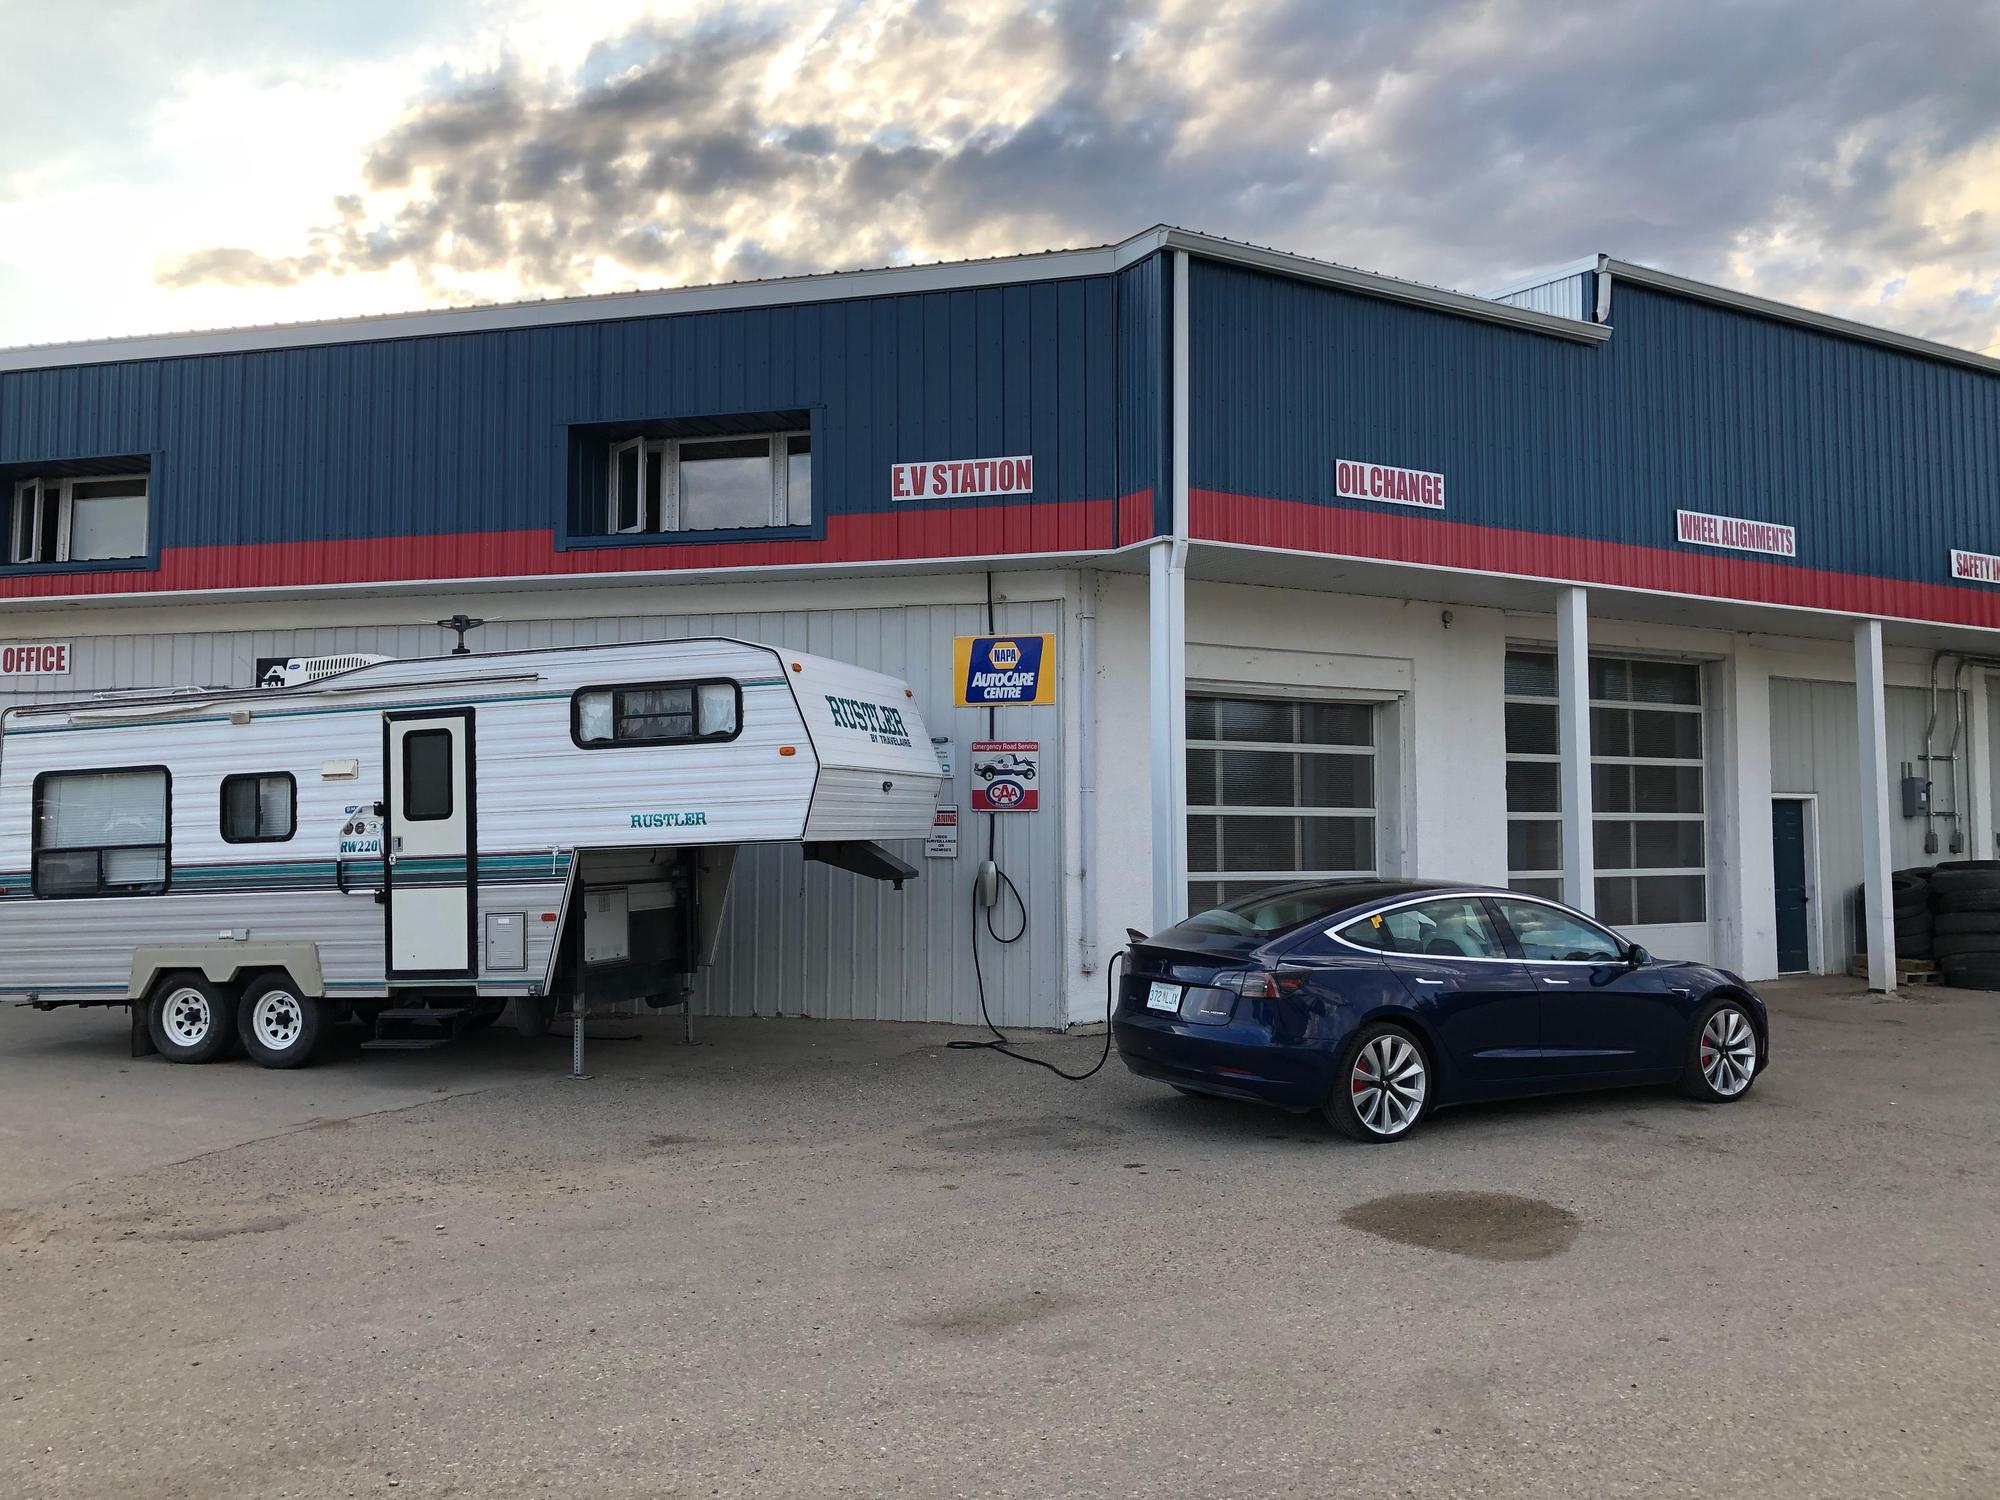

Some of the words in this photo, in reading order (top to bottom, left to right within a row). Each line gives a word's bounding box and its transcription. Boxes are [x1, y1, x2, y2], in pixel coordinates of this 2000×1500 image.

[893, 465, 927, 497] E.V
[932, 459, 1031, 495] STATION
[1338, 462, 1368, 496] OIL
[1370, 466, 1443, 506] CHANGE
[1679, 512, 1720, 544] WHEEL
[1721, 519, 1793, 555] ALIGNMENTS
[1956, 552, 1990, 580] SAFETY
[2, 645, 66, 673] OFFICE
[994, 649, 1017, 662] NAPA
[983, 686, 1022, 699] CENTRE
[824, 694, 909, 738] RUSTLER
[869, 733, 878, 743] BY
[972, 743, 1002, 751] Emergency
[991, 784, 1018, 802] CAA
[630, 811, 707, 828] RUSTLER
[340, 841, 378, 853] RW220
